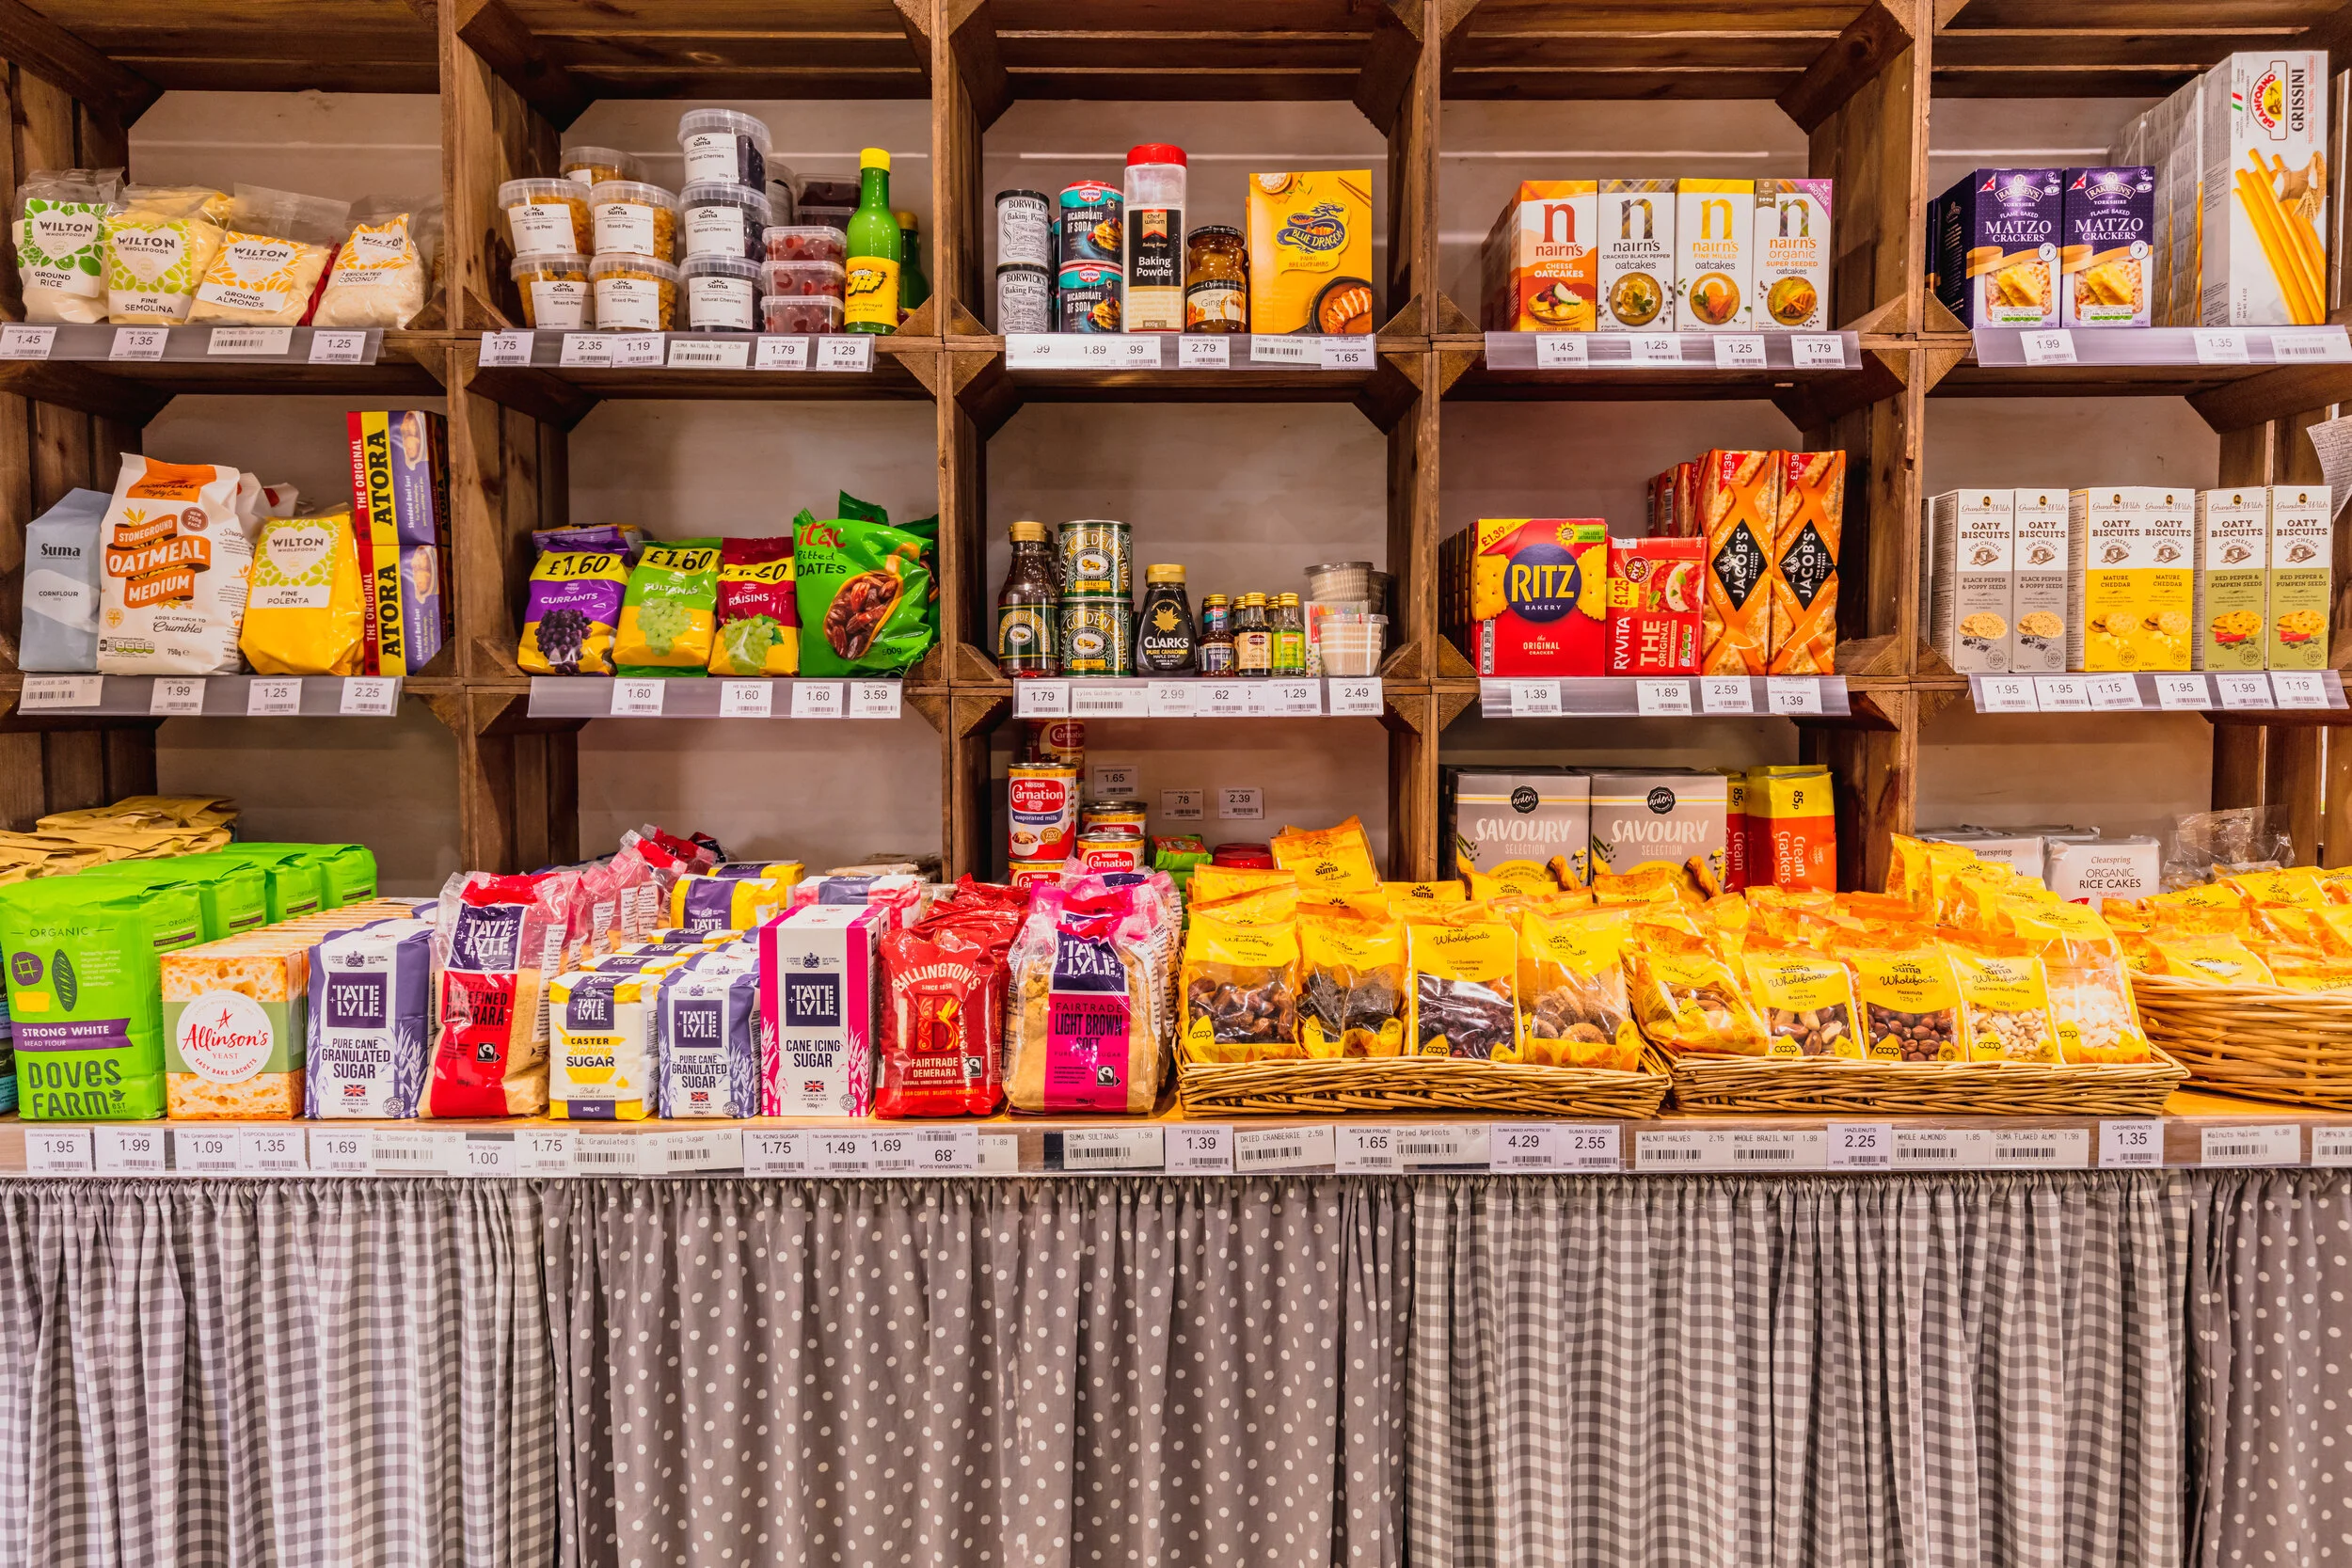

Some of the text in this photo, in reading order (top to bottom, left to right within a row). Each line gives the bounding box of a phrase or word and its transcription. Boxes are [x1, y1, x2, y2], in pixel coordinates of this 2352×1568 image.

[2257, 73, 2277, 128] GRANFORNO
[2291, 68, 2305, 132] GRISSINI
[39, 221, 93, 233] WILTON
[2074, 218, 2144, 232] MATZO
[1292, 229, 1343, 250] BLUE DRAGON
[2082, 230, 2135, 241] CRACKERS
[1535, 244, 1582, 257] nairn's
[1613, 240, 1660, 253] nairn's
[234, 246, 289, 259] WILTON
[1769, 249, 1815, 261] organic
[1138, 257, 1170, 270] Baking
[1615, 261, 1656, 270] oatcakes
[34, 271, 72, 281] GROUND
[1136, 267, 1173, 277] Powder
[1534, 269, 1583, 278] OATCAKES
[40, 277, 62, 288] RICE
[224, 290, 261, 301] GROUND
[215, 295, 264, 308] ALMONDS
[1201, 298, 1229, 309] Ginger
[124, 303, 174, 314] SEMOLINA
[16, 334, 41, 345] 1.45
[128, 335, 153, 346] 1.35
[327, 338, 351, 349] 1.25
[1645, 341, 1668, 349] 1.25
[2036, 339, 2059, 349] 1.99
[492, 341, 516, 350] 1.75
[578, 341, 602, 351] 2.35
[626, 341, 650, 351] 1.19
[771, 344, 795, 355] 1.79
[833, 344, 855, 355] 1.29
[1083, 345, 1106, 355] 1.89
[1192, 343, 1216, 353] 2.79
[1550, 342, 1573, 351] 1.45
[1807, 343, 1831, 353] 1.79
[1334, 353, 1359, 362] 1.65
[1722, 453, 1733, 481] £1.39
[354, 439, 367, 510] THE ORIGINAL
[368, 430, 393, 527] ATORA
[2287, 519, 2316, 528] OATY
[119, 520, 173, 543] STONEGROUND
[1480, 527, 1505, 546] £1.39
[2277, 528, 2328, 536] BISCUITS
[40, 543, 81, 557] Suma
[109, 538, 205, 572] OATMEAL
[546, 555, 612, 576] £1.60
[1800, 530, 1815, 597] JACOB'S
[797, 563, 847, 578] DATES
[129, 574, 189, 602] MEDIUM
[1512, 563, 1575, 602] RITZ
[1612, 578, 1629, 606] £1.25
[267, 596, 310, 605] POLENTA
[541, 593, 597, 604] CURRANTS
[728, 594, 770, 606] RAISINS
[1144, 637, 1189, 650] CLARKS
[1523, 641, 1560, 650] ORIGINAL
[1640, 622, 1660, 667] THE
[1659, 621, 1669, 667] ORIGINAL
[167, 686, 190, 696] 1.99
[1714, 685, 1738, 694] 2.59
[1995, 684, 2019, 694] 1.95
[2232, 683, 2256, 692] 1.99
[2286, 681, 2309, 690] 1.19
[263, 688, 287, 698] 1.25
[355, 688, 380, 698] 2.25
[627, 689, 651, 699] 1.60
[864, 690, 887, 700] 3.59
[1031, 691, 1055, 702] 1.79
[1283, 689, 1307, 698] 1.29
[1345, 689, 1369, 698] 2.49
[1523, 689, 1548, 699] 1.39
[1655, 688, 1678, 697] 1.89
[1104, 773, 1124, 783] 1.65
[1010, 788, 1063, 800] Carnation
[1230, 795, 1250, 803] 2.39
[1792, 790, 1804, 810] 85p
[1475, 818, 1572, 844] SAVOURY
[1505, 844, 1546, 856] SELECTION
[1794, 837, 1805, 877] Cream
[2091, 855, 2131, 865] Clearspring
[2086, 868, 2134, 878] ORGANIC
[2079, 879, 2141, 889] RICE CAKES
[29, 927, 88, 937] ORGANIC
[891, 962, 981, 992] BILLINGTON'S
[332, 984, 379, 1002] TATE
[337, 998, 379, 1017] LYLE
[1055, 1003, 1122, 1012] FAIRTRADE
[22, 1024, 109, 1037] STRONG WHITE
[1055, 1014, 1122, 1037] LIGHT BROWN
[182, 1023, 269, 1052] Allinson's
[332, 1037, 378, 1049] PURE CANE
[787, 1038, 841, 1053] CANE ICING
[322, 1049, 390, 1063] GRANULATED
[566, 1056, 614, 1067] SUGAR
[911, 1057, 958, 1067] FAIRTRADE
[333, 1064, 375, 1079] SUGAR
[913, 1069, 957, 1077] DEMERARA
[1089, 1132, 1119, 1141] SULTANAS
[1240, 1134, 1259, 1143] DRIED
[1263, 1132, 1300, 1142] CRANBERRIE
[1420, 1129, 1450, 1137] Apricots
[2117, 1132, 2147, 1145] 1.35
[119, 1139, 150, 1151] 1.99
[532, 1140, 563, 1151] 1.75
[1186, 1137, 1216, 1149] 1.39
[1358, 1136, 1388, 1148] 1.65
[1509, 1135, 1540, 1148] 4.29
[1575, 1137, 1606, 1148] 2.55
[1845, 1134, 1876, 1148] 2.25
[43, 1141, 74, 1153] 1.95
[193, 1141, 223, 1153] 1.09
[326, 1141, 357, 1153] 1.69
[825, 1143, 855, 1154] 1.49
[469, 1152, 499, 1164] 1.00
